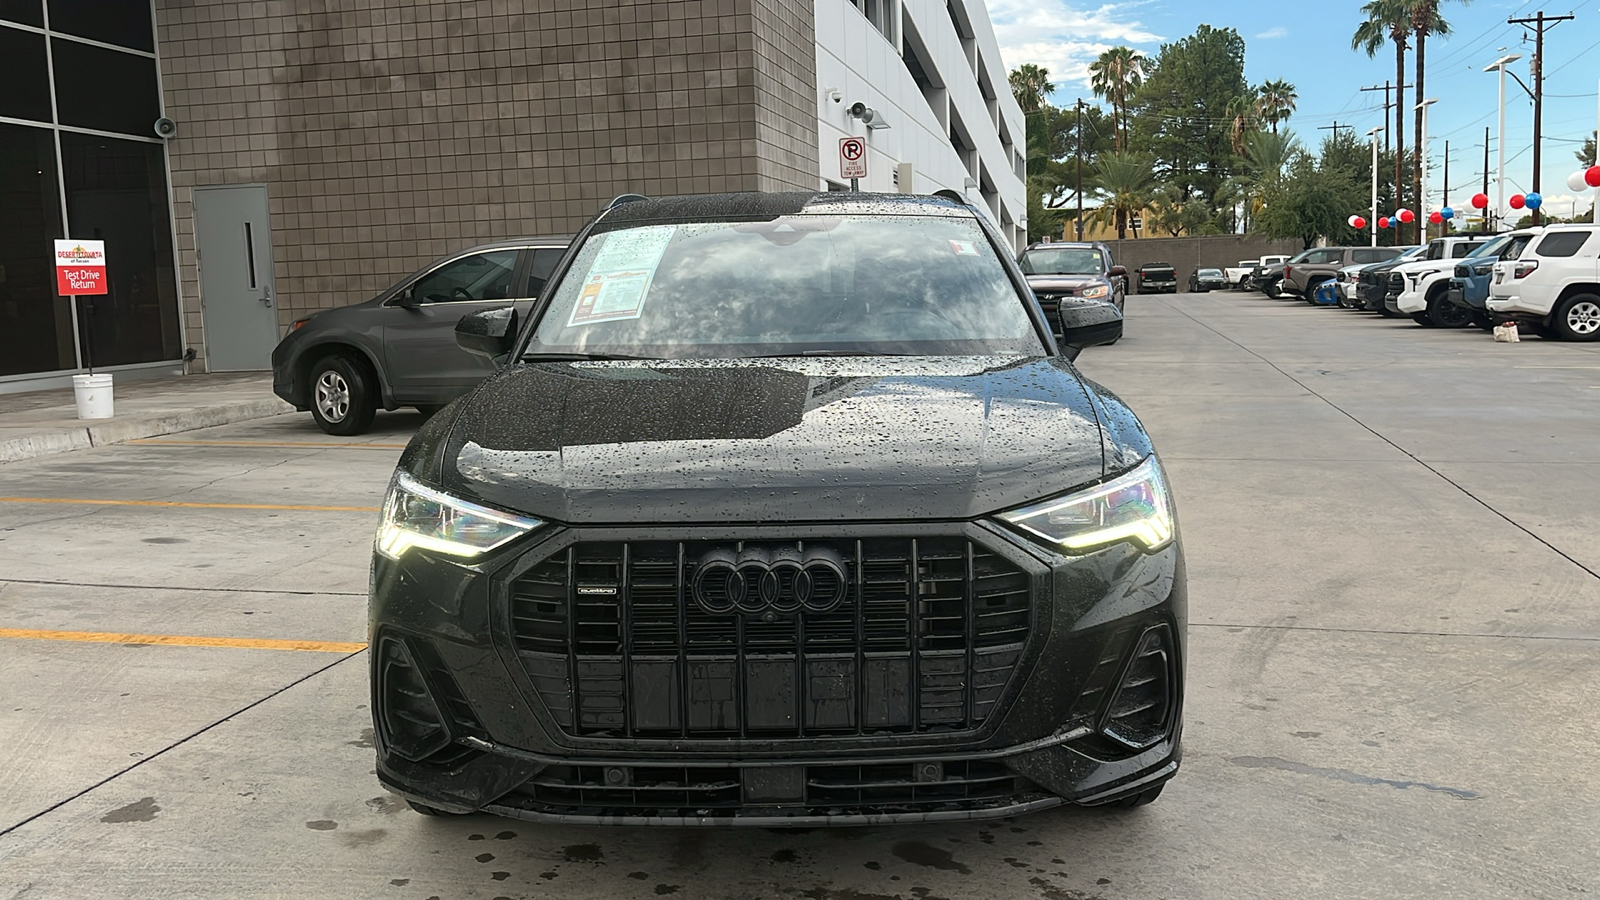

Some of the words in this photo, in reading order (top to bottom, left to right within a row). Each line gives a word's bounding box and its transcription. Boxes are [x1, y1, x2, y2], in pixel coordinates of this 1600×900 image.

[64, 270, 80, 280] Test
[81, 270, 99, 280] Drive
[71, 280, 95, 289] Return
